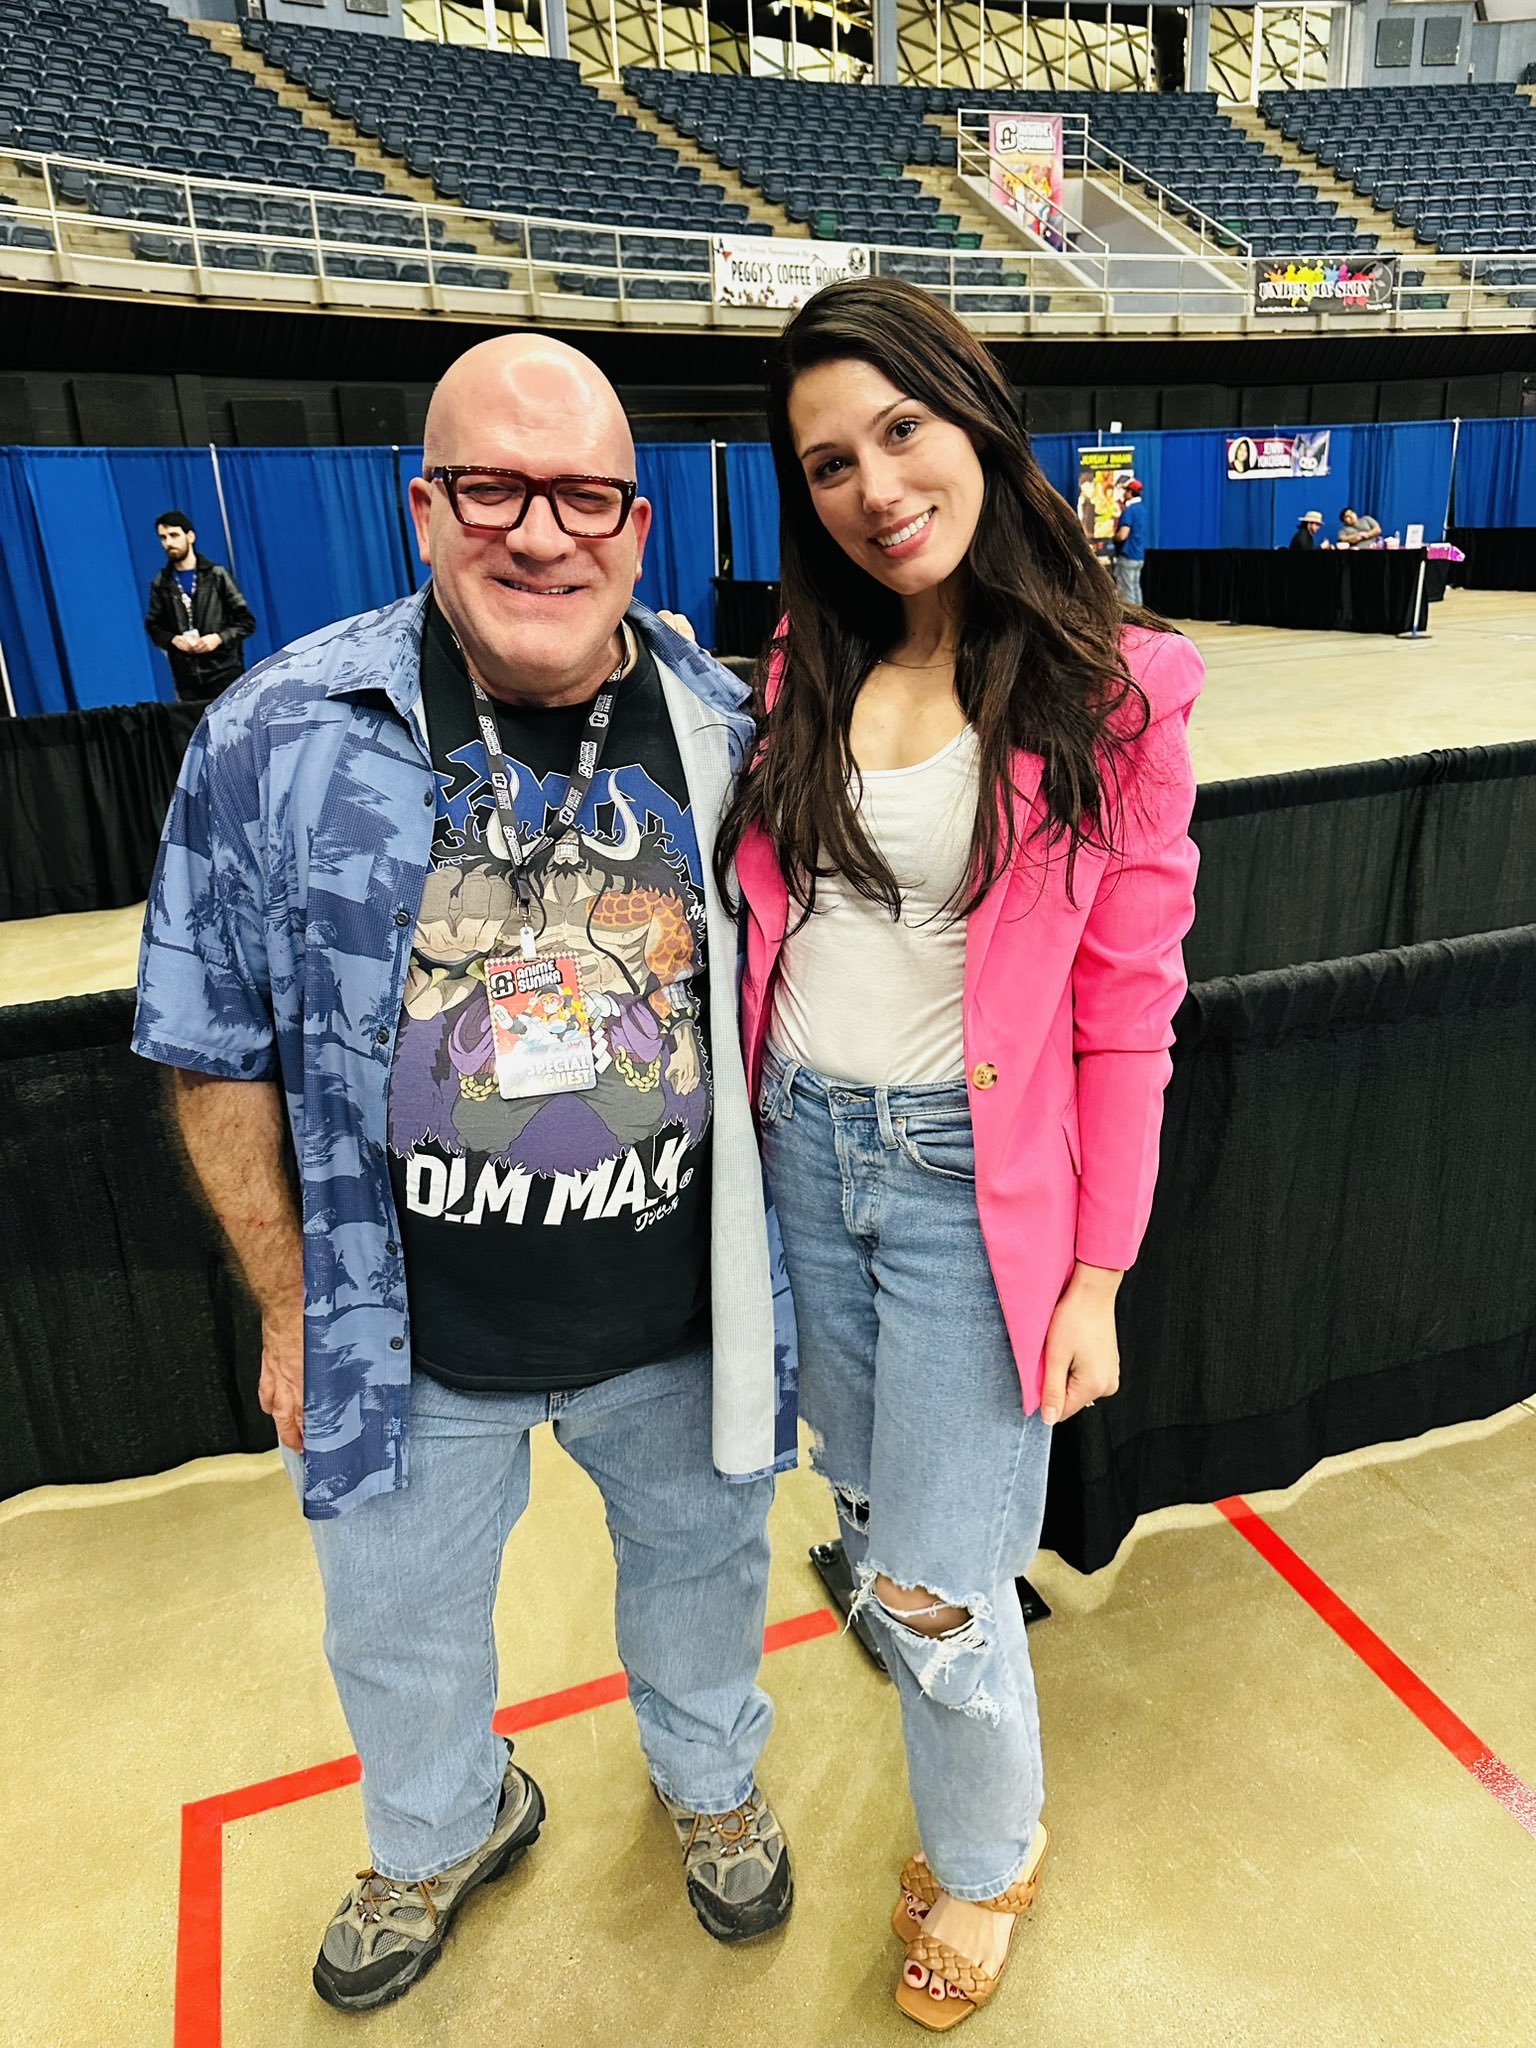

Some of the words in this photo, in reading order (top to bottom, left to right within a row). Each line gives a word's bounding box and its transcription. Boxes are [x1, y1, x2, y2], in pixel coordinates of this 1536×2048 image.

[731, 261, 773, 284] PEGGY'S
[777, 264, 811, 287] COFFEE
[1259, 282, 1309, 300] UNDER
[1312, 281, 1334, 298] MY
[1335, 280, 1371, 298] SKIN
[516, 960, 556, 980] ANIME
[518, 970, 562, 993] SUNIKA
[526, 1055, 590, 1077] SPECIAL
[543, 1069, 591, 1088] GUEST
